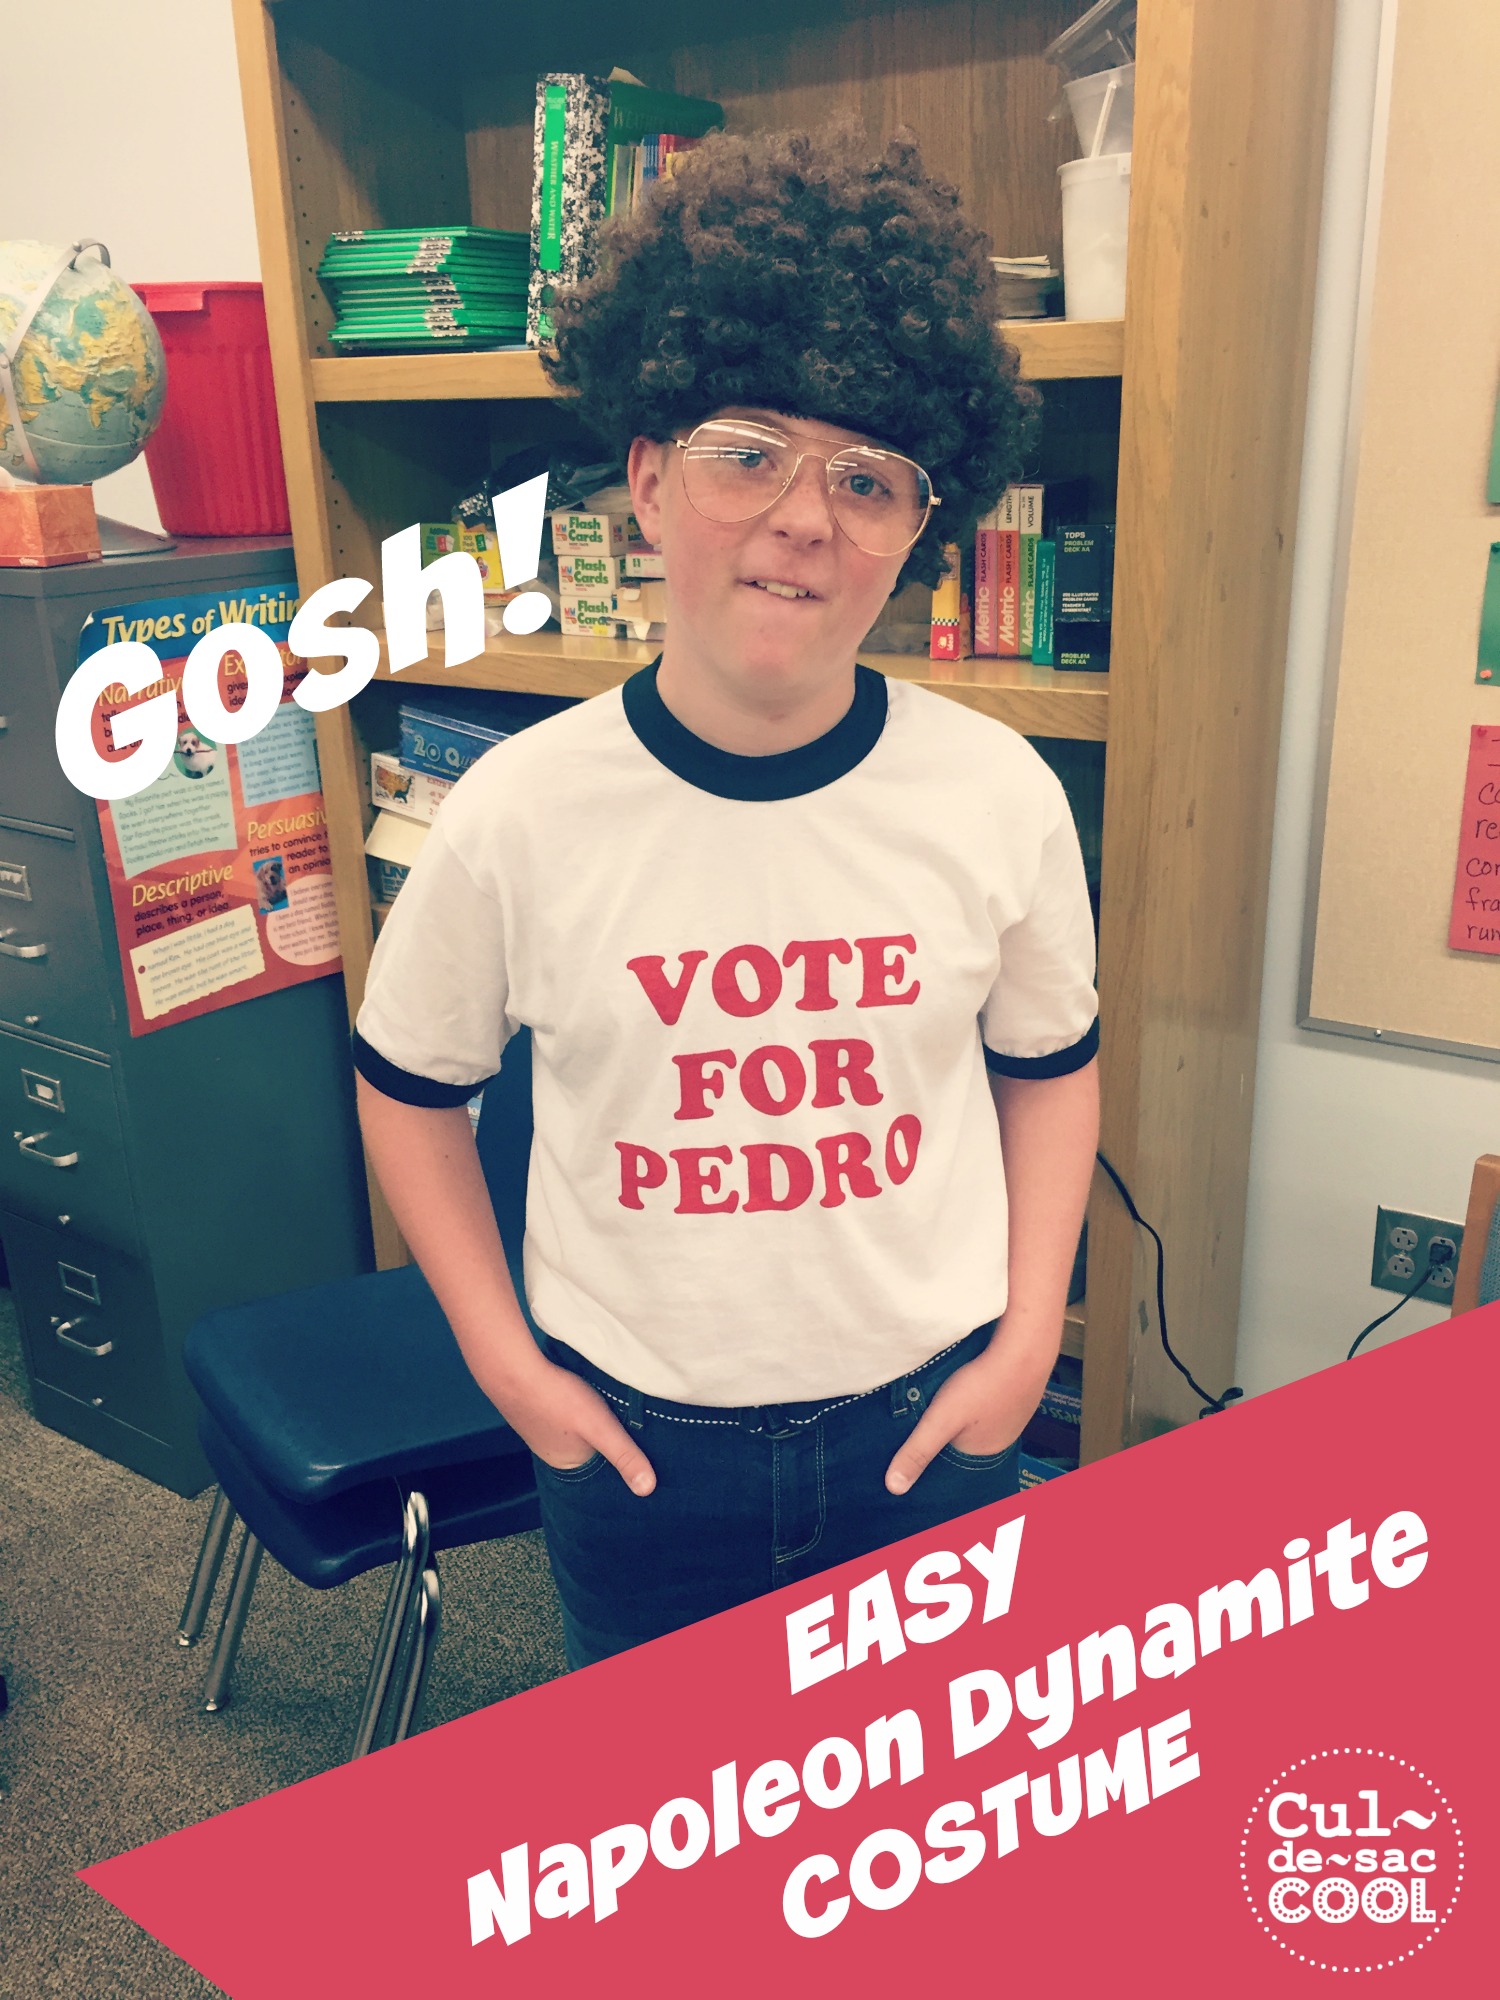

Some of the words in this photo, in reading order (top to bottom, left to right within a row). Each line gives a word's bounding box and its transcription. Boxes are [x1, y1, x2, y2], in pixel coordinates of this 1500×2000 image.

[569, 517, 601, 529] Flash
[568, 530, 603, 543] Cards
[574, 571, 608, 584] Cards
[575, 558, 606, 571] Flash
[191, 609, 215, 634] of
[218, 592, 300, 626] Writin
[577, 600, 608, 613] Flash
[975, 586, 989, 646] Metric
[1000, 586, 1015, 646] Metric
[1022, 590, 1035, 647] Metric
[414, 734, 441, 762] 20
[248, 806, 327, 842] Persuasiv
[1475, 818, 1500, 840] re
[249, 845, 269, 857] tries
[272, 843, 281, 851] to
[283, 833, 321, 848] convince
[287, 847, 316, 861] reader
[303, 858, 331, 872] opinio
[132, 865, 233, 907] Descriptive
[135, 903, 179, 921] describes
[626, 933, 921, 1026] VOTE
[672, 1038, 884, 1120] FOR
[614, 1113, 922, 1214] PEDRO
